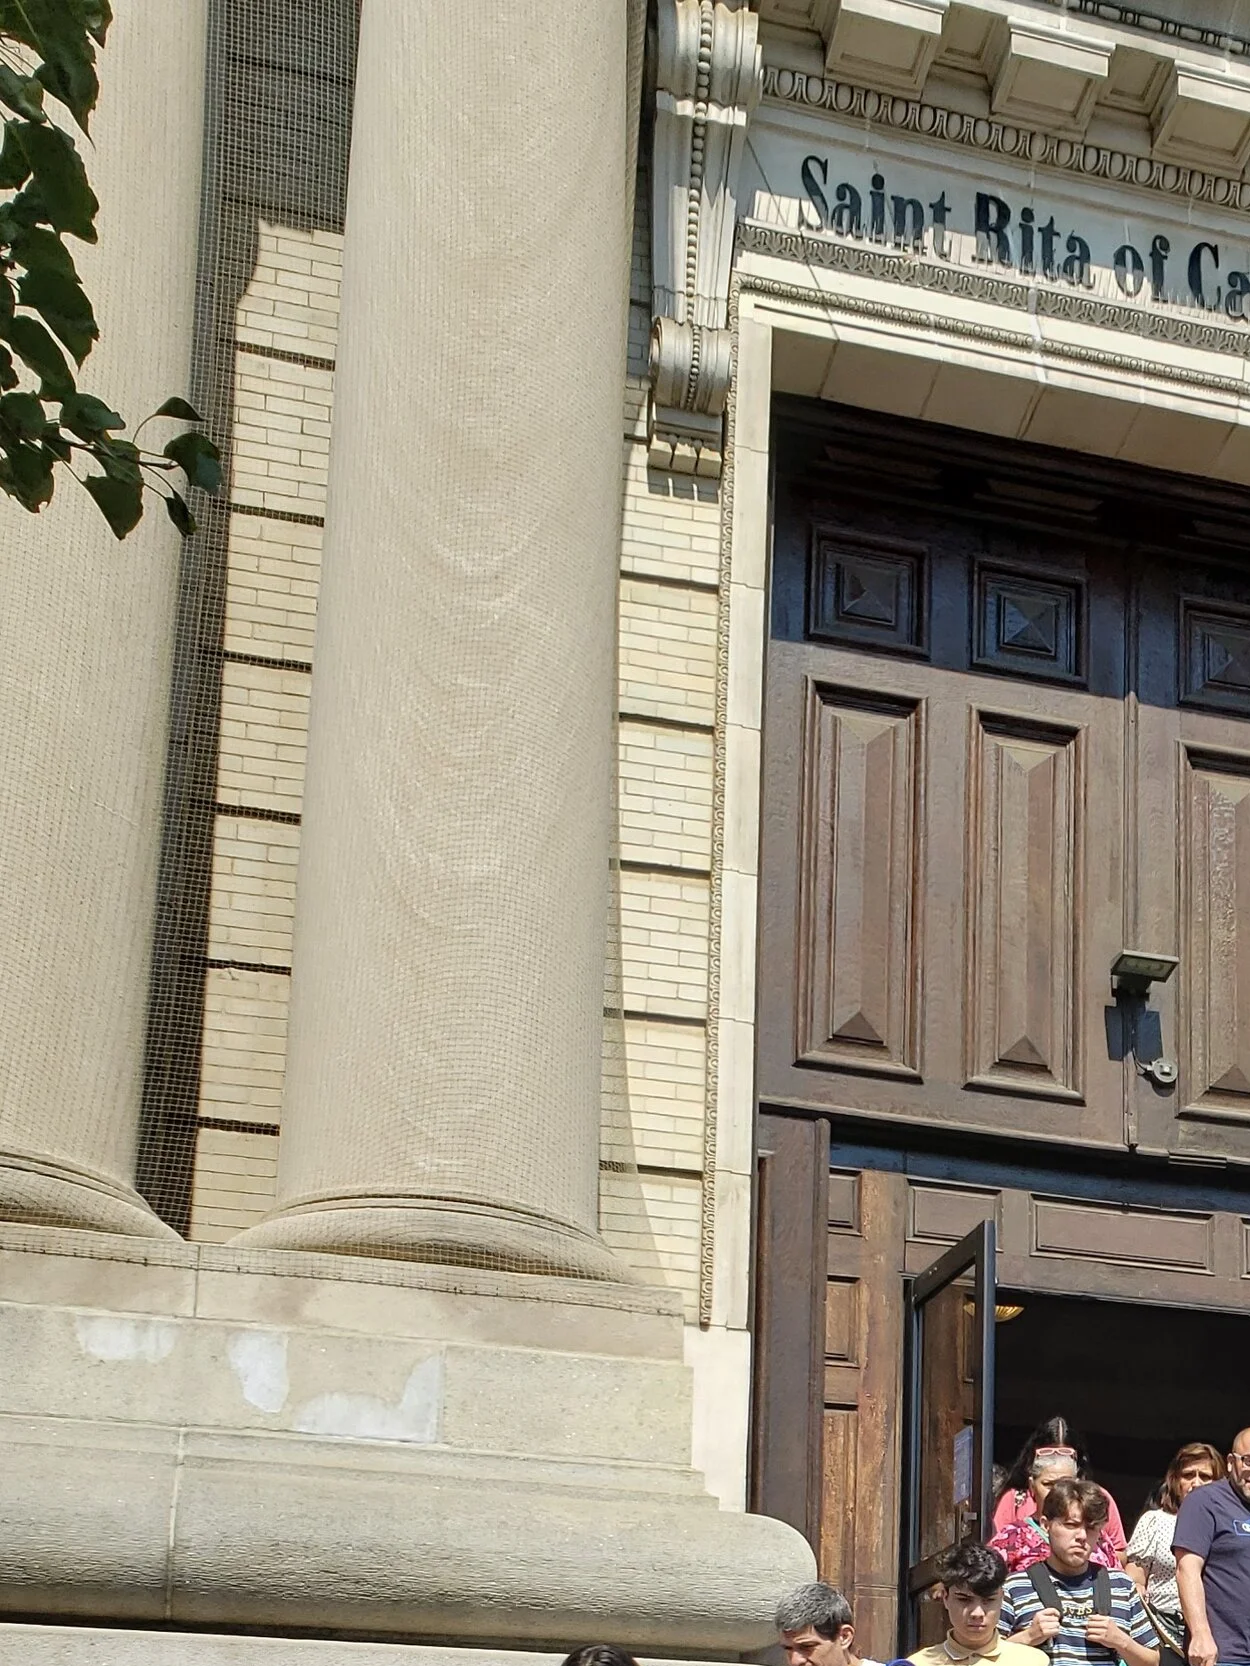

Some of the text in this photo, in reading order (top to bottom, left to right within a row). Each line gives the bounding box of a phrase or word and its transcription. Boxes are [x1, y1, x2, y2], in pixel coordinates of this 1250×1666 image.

[800, 154, 952, 259] Saint
[971, 191, 1096, 290] Rita
[1113, 234, 1171, 302] of
